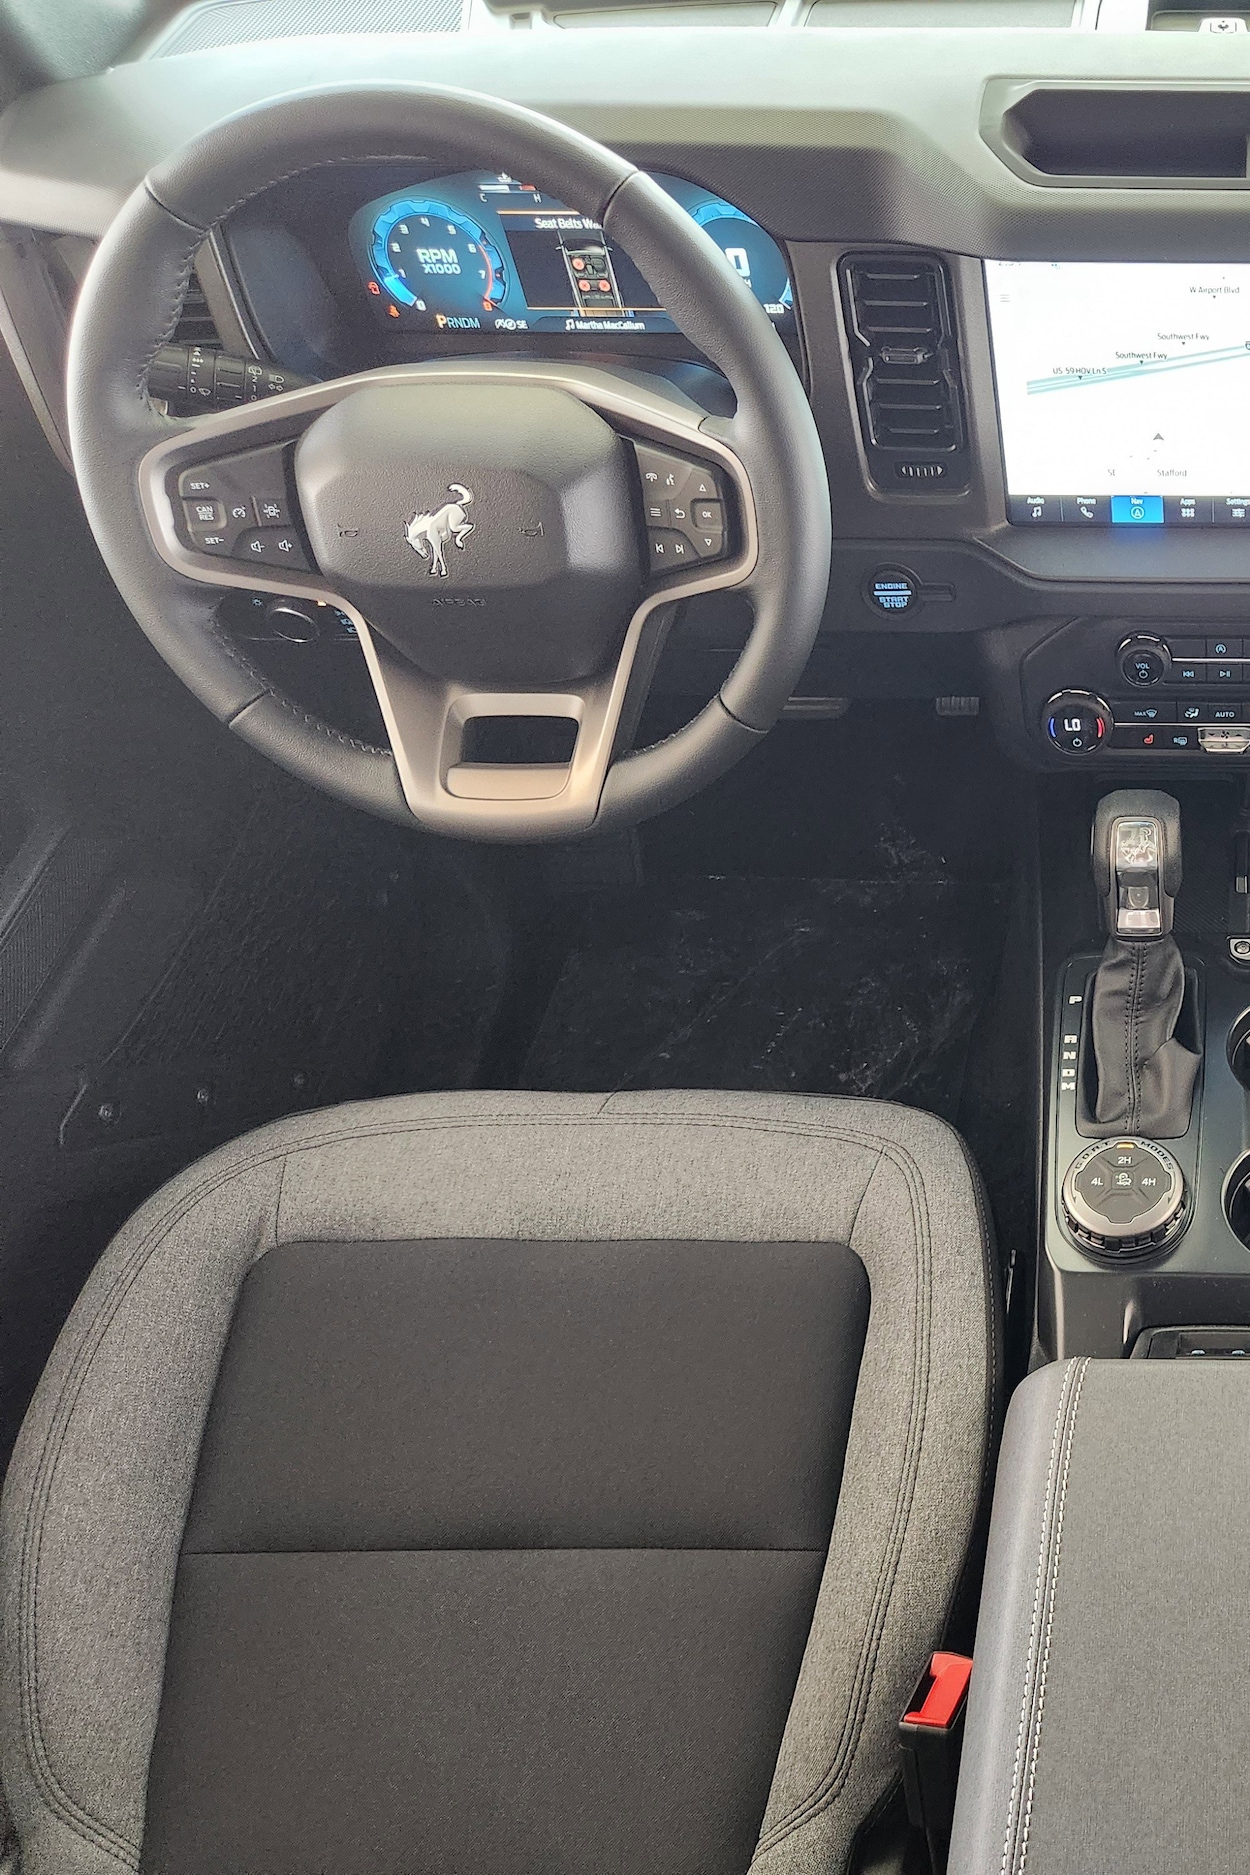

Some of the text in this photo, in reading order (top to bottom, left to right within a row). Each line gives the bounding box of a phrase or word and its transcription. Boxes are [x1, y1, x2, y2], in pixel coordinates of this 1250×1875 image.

[479, 194, 488, 202] C
[533, 194, 542, 203] H
[534, 217, 558, 229] Seat
[557, 217, 583, 229] Belts
[416, 248, 459, 263] RPM
[724, 247, 751, 277] 0
[422, 263, 461, 274] X1000
[1189, 286, 1240, 296] W Airport Blvd
[415, 300, 427, 311] 0
[763, 303, 785, 314] 120
[436, 313, 480, 328] PRNDM
[517, 319, 528, 330] SE
[575, 322, 603, 330] Martha
[1157, 332, 1210, 342] Southwest Fwy
[1115, 352, 1168, 361] Southwest Fwy
[1076, 367, 1091, 375] HOV
[1092, 367, 1101, 375] Ln
[1102, 367, 1107, 375] S
[1157, 468, 1187, 477] Stafford
[190, 482, 210, 490] SET+
[1027, 496, 1045, 505] Audio
[1076, 496, 1097, 505] Phone
[1130, 496, 1144, 505] Nav
[1180, 497, 1196, 507] Apps
[1226, 497, 1250, 507] Settings
[875, 582, 908, 590] ENGINE
[1135, 662, 1150, 670] VOL
[1069, 995, 1082, 1005] P
[1063, 1051, 1077, 1060] N
[1062, 1068, 1076, 1078] D
[1061, 1082, 1076, 1091] M
[1117, 1156, 1132, 1165] 2H
[1140, 1141, 1175, 1170] MODES
[1090, 1177, 1104, 1187] 4L
[1141, 1177, 1157, 1187] 4H
